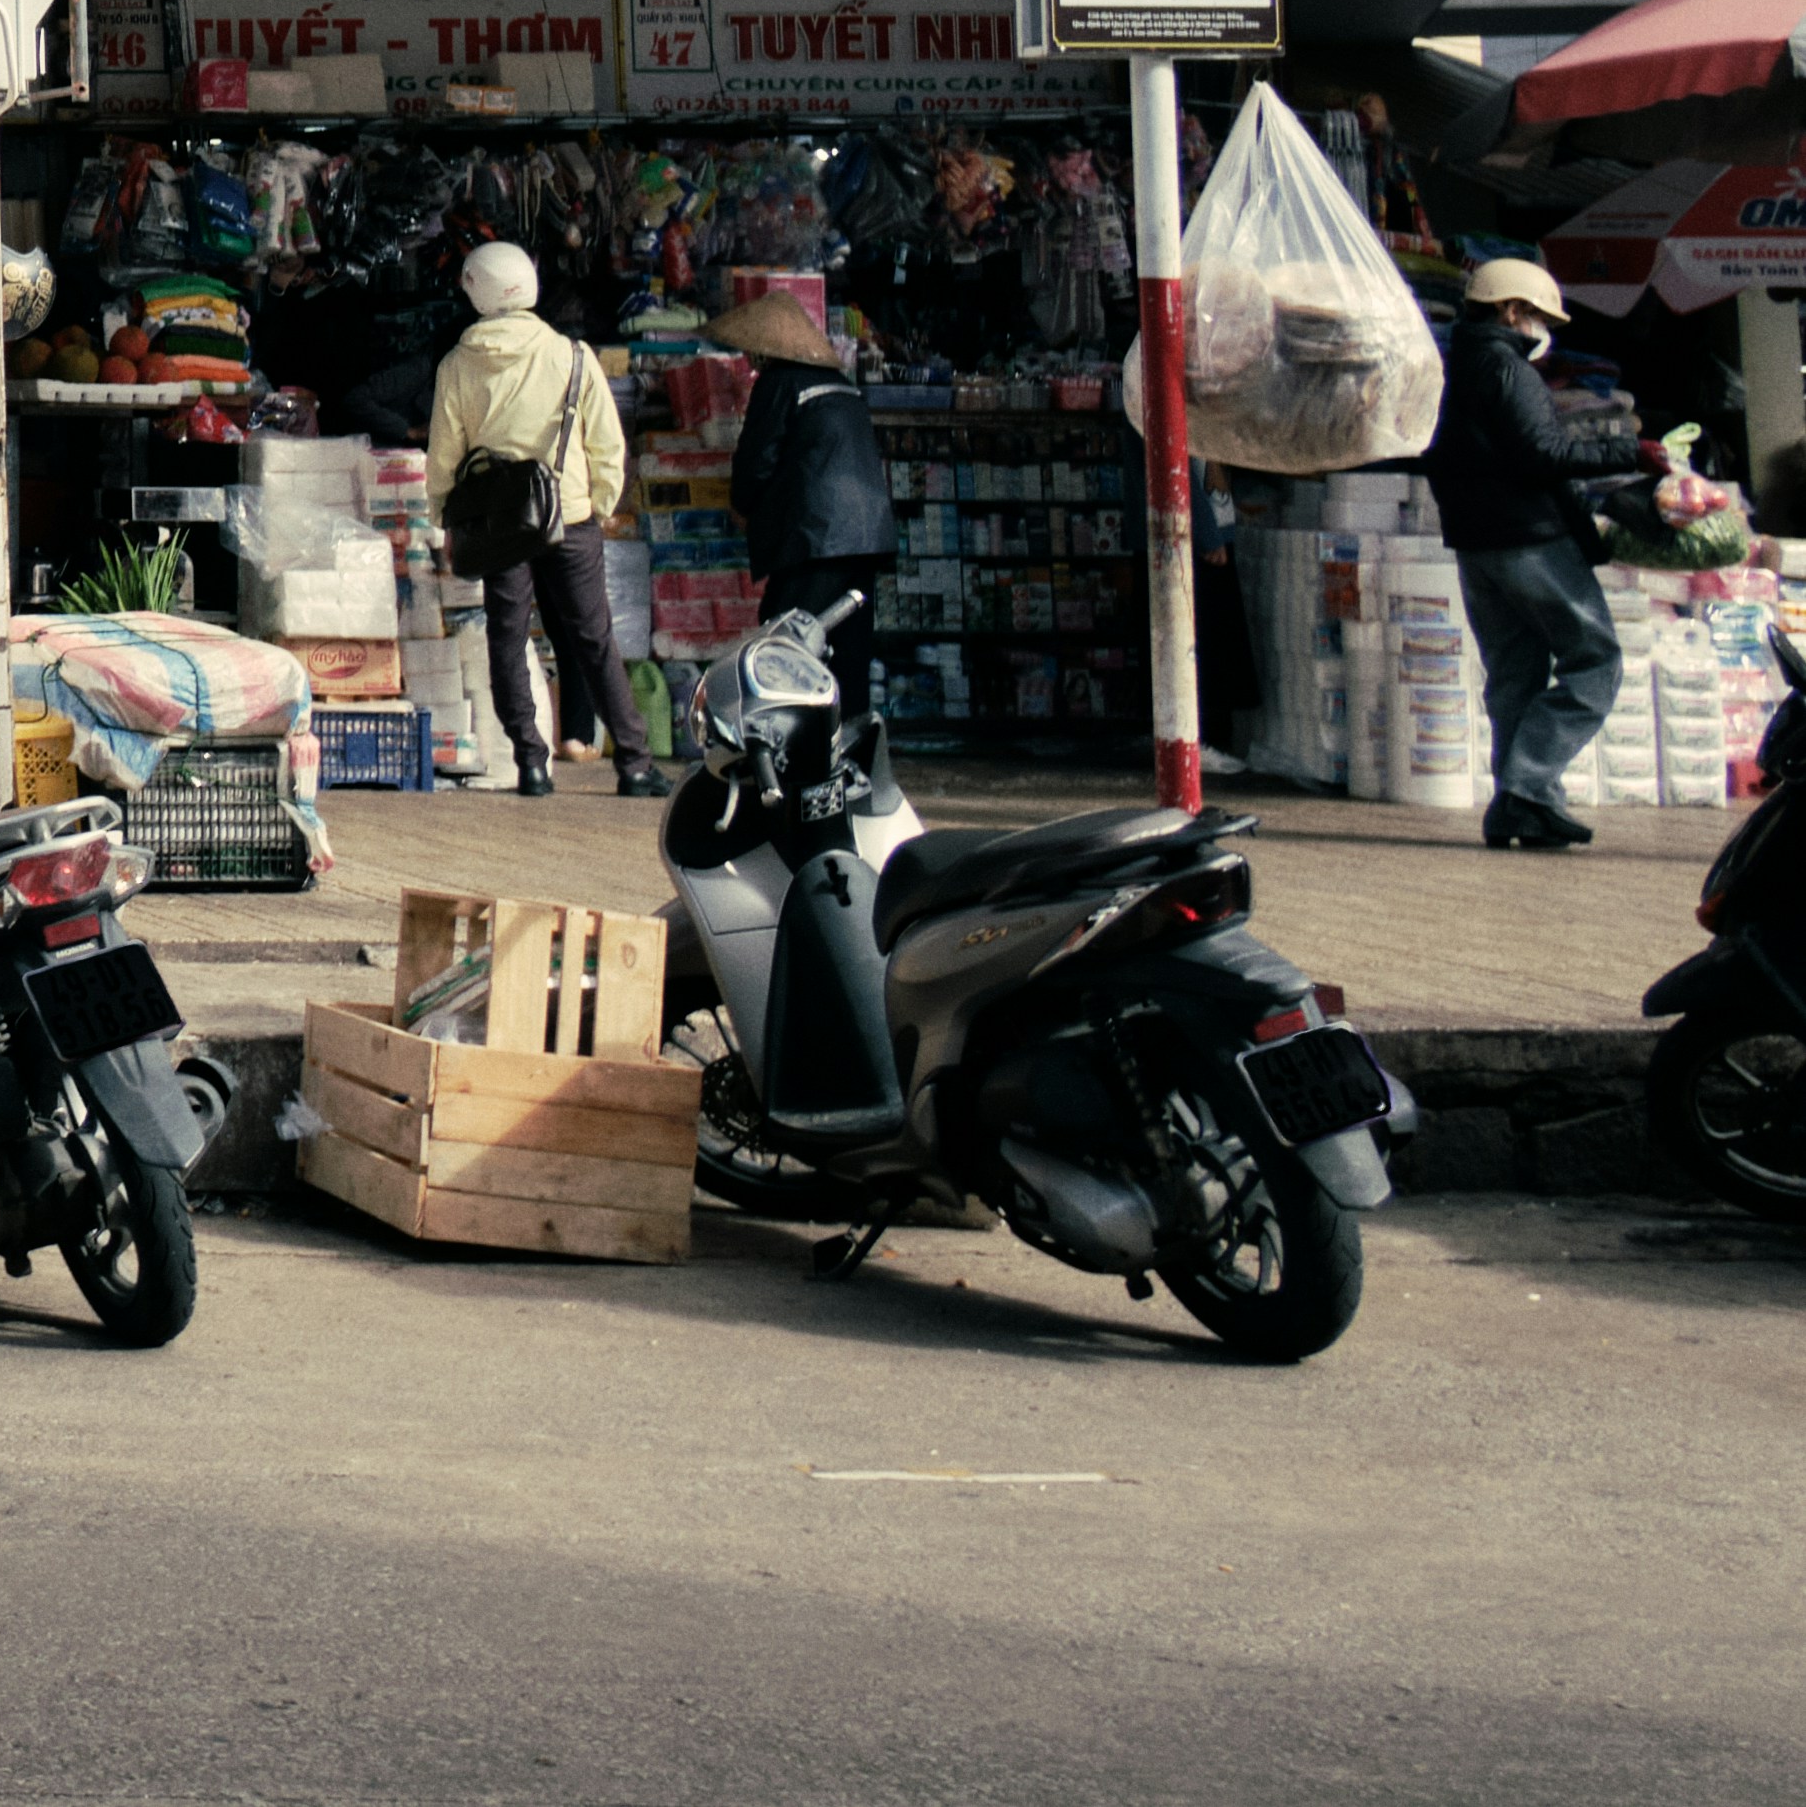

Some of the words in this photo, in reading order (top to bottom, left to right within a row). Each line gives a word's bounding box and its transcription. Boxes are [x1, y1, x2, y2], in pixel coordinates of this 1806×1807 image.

[649, 31, 695, 67] 47
[728, 0, 897, 61] TUYẾT
[100, 31, 147, 68] 46
[726, 76, 845, 92] CHUYÊN
[854, 77, 936, 92] CUNG
[946, 72, 1002, 92] CẤP
[808, 97, 851, 112] 844
[49, 954, 137, 1006] 49-D1
[51, 987, 168, 1050] 518.56
